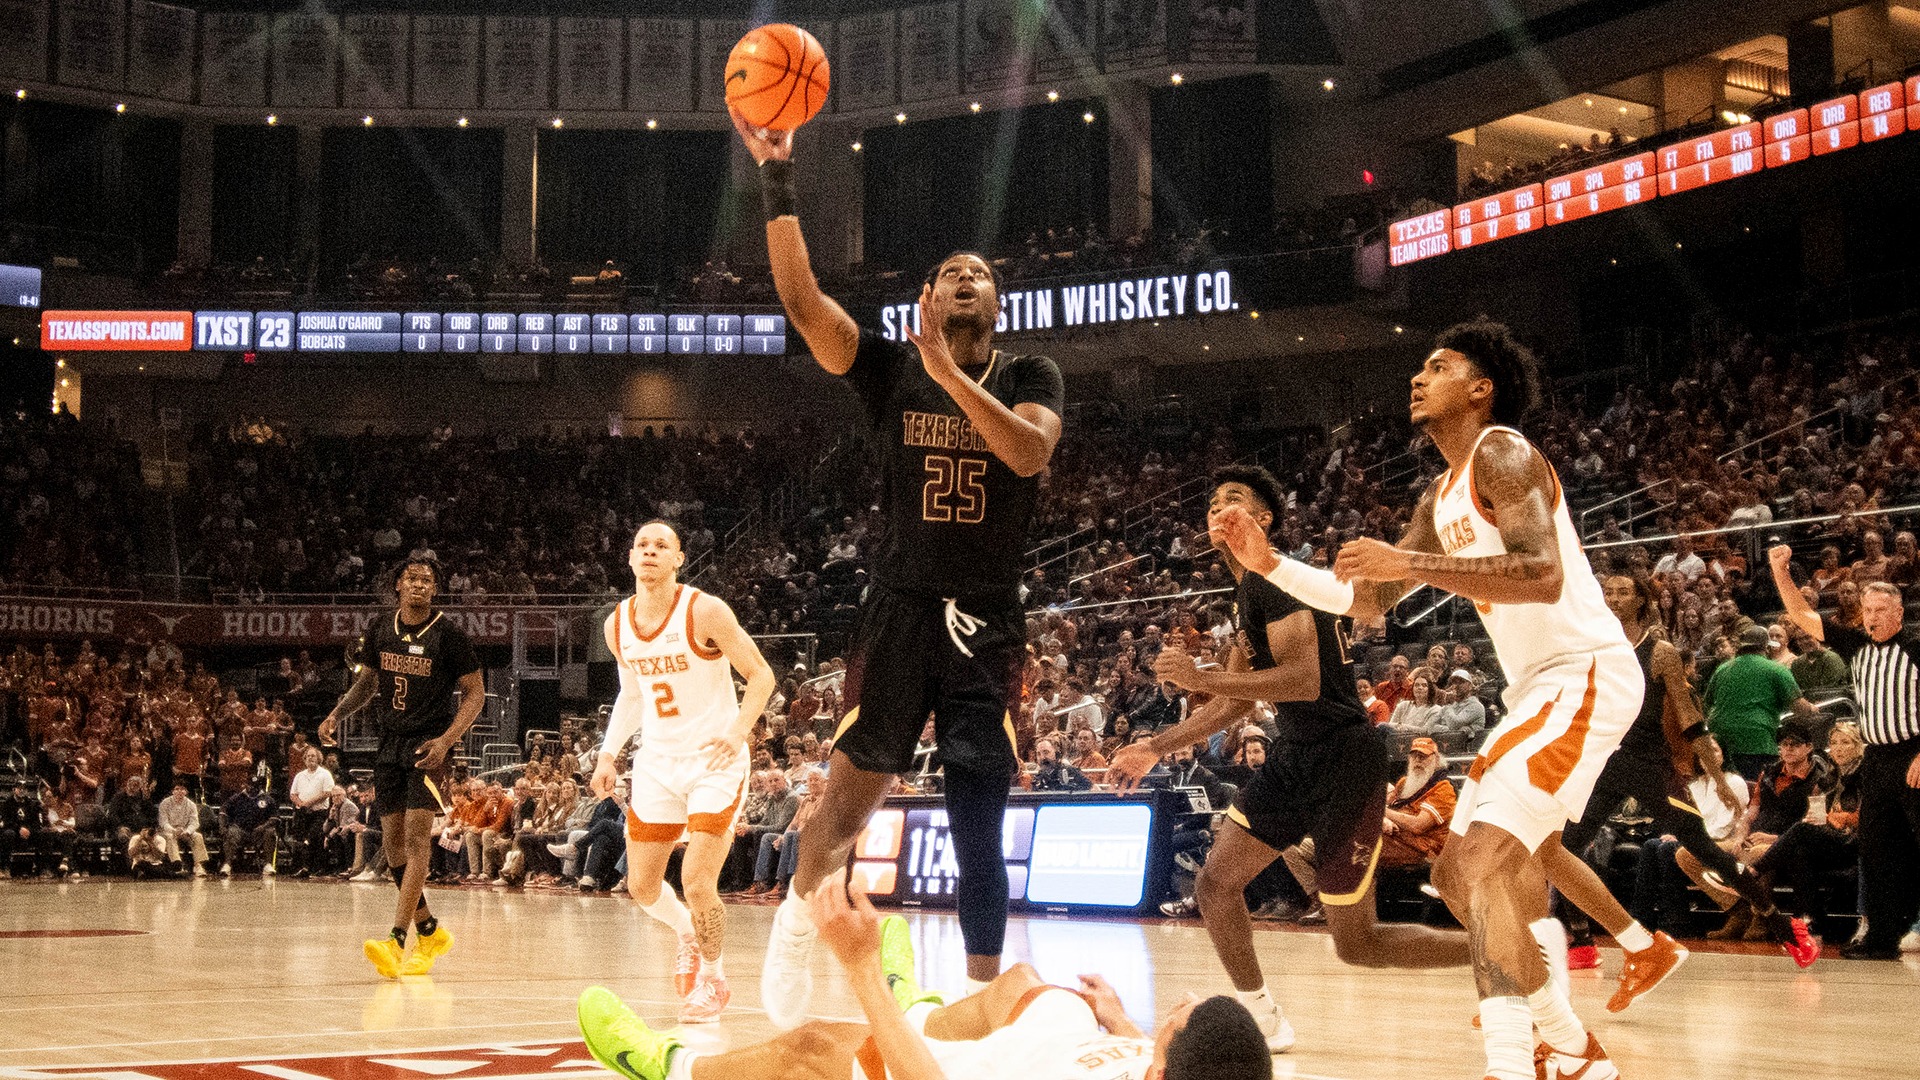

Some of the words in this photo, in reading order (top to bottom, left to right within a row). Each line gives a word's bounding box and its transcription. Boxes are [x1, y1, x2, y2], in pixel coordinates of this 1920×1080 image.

[1460, 208, 1470, 225] FG
[1485, 201, 1500, 218] FGA
[1516, 191, 1534, 209] FG%
[1551, 181, 1570, 199] 3PM
[1586, 172, 1604, 191] 3PA
[1624, 160, 1644, 180] 3P%
[1666, 151, 1677, 169] FT
[1696, 142, 1714, 159] FTA
[1731, 132, 1752, 151] FT%
[1774, 118, 1796, 139] ORB
[1822, 104, 1845, 126] DRB
[1869, 91, 1891, 112] REB
[1460, 227, 1471, 246] 10
[1488, 220, 1498, 239] 17
[1516, 211, 1530, 230] 58
[1556, 202, 1563, 220] 4
[1590, 193, 1598, 212] 6
[1625, 183, 1640, 202] 66
[1670, 173, 1677, 190] 1
[1703, 164, 1709, 181] 1
[1731, 151, 1752, 173] 100
[1781, 142, 1791, 162] 5
[1830, 128, 1840, 148] 9
[1873, 115, 1888, 136] 14
[1397, 214, 1444, 241] TEXAS
[1392, 243, 1418, 264] TEAM
[1420, 235, 1449, 258] STATS
[882, 303, 920, 342] STI
[995, 289, 1052, 333] STIN
[1063, 275, 1187, 326] WHISKEY
[1198, 271, 1238, 313] CO.
[48, 320, 184, 342] TEXASSPORTS.COM
[198, 316, 250, 346] TXST
[260, 317, 290, 347] 23
[299, 316, 337, 330] JOSHUA
[338, 316, 382, 330] O'GARRO
[412, 316, 431, 330] PTS
[451, 316, 472, 330] ORB
[488, 316, 509, 330] DRB
[525, 316, 545, 330] REB
[563, 316, 582, 330] AST
[601, 316, 619, 331] FLS
[638, 316, 657, 331] STL
[677, 316, 697, 331] BLK
[718, 316, 730, 331] FT
[754, 316, 775, 331] MIN
[301, 335, 345, 349] BOBCATS
[418, 335, 426, 350] 0
[457, 335, 466, 350] 0
[495, 335, 503, 350] 0
[532, 335, 540, 350] 0
[570, 335, 578, 350] 0
[607, 335, 614, 350] 1
[644, 335, 653, 351] 0
[682, 335, 691, 351] 0
[715, 335, 734, 351] 0-0
[762, 335, 769, 351] 1
[903, 411, 960, 449] TEXAS
[923, 455, 987, 523] 25
[222, 612, 310, 637] HOOK
[627, 653, 691, 676] TEXAS
[392, 676, 407, 711] 2
[651, 682, 681, 718] 2
[908, 827, 959, 877] 11:4
